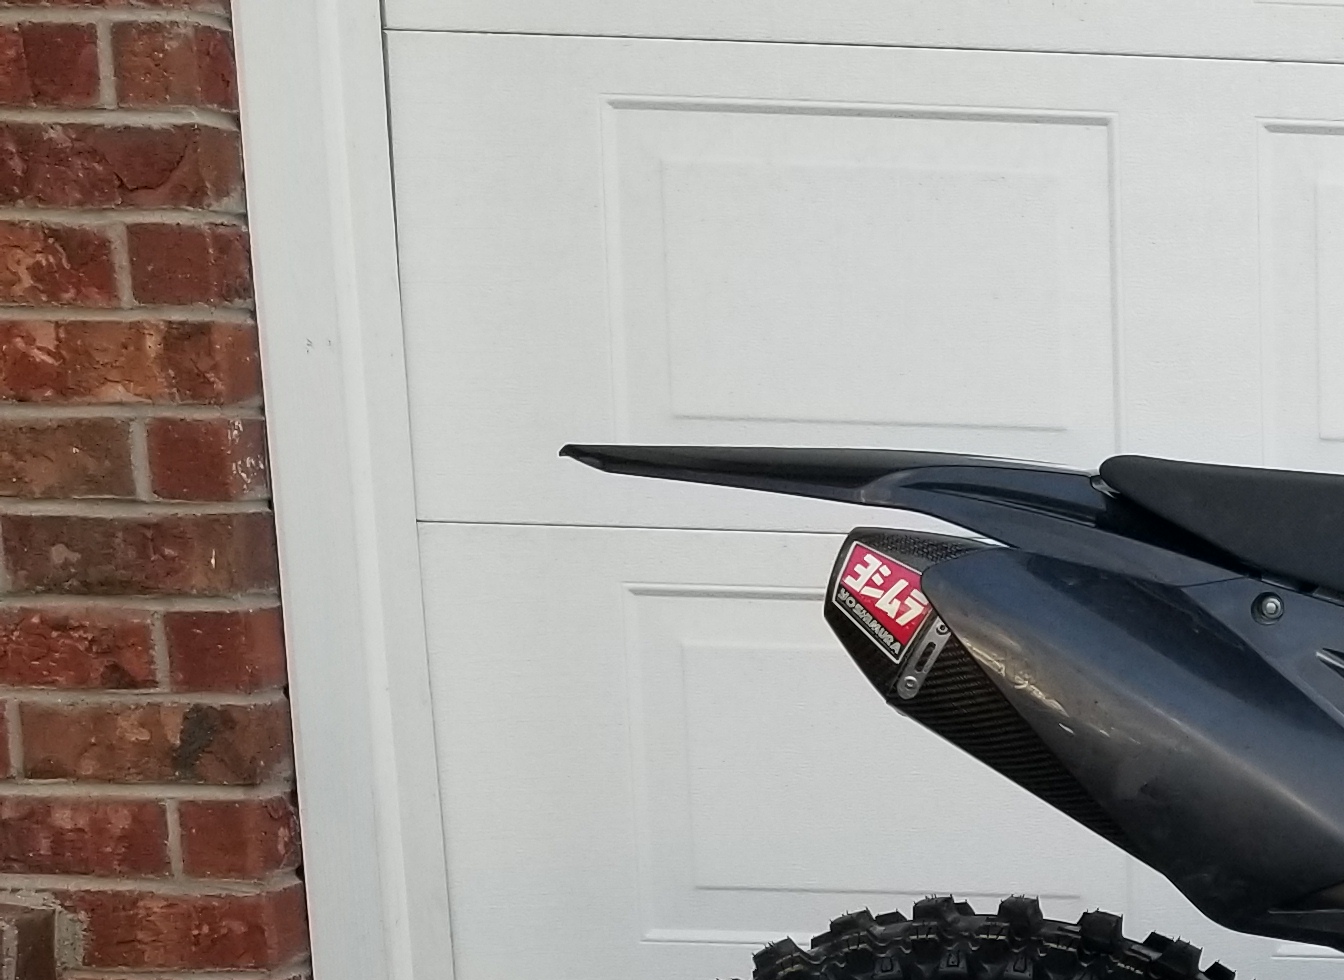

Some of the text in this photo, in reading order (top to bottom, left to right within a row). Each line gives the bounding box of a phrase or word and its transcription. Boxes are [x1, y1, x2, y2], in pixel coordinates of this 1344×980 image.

[837, 587, 901, 655] YOSHIMURA
[842, 553, 930, 627] ヨシムラ
